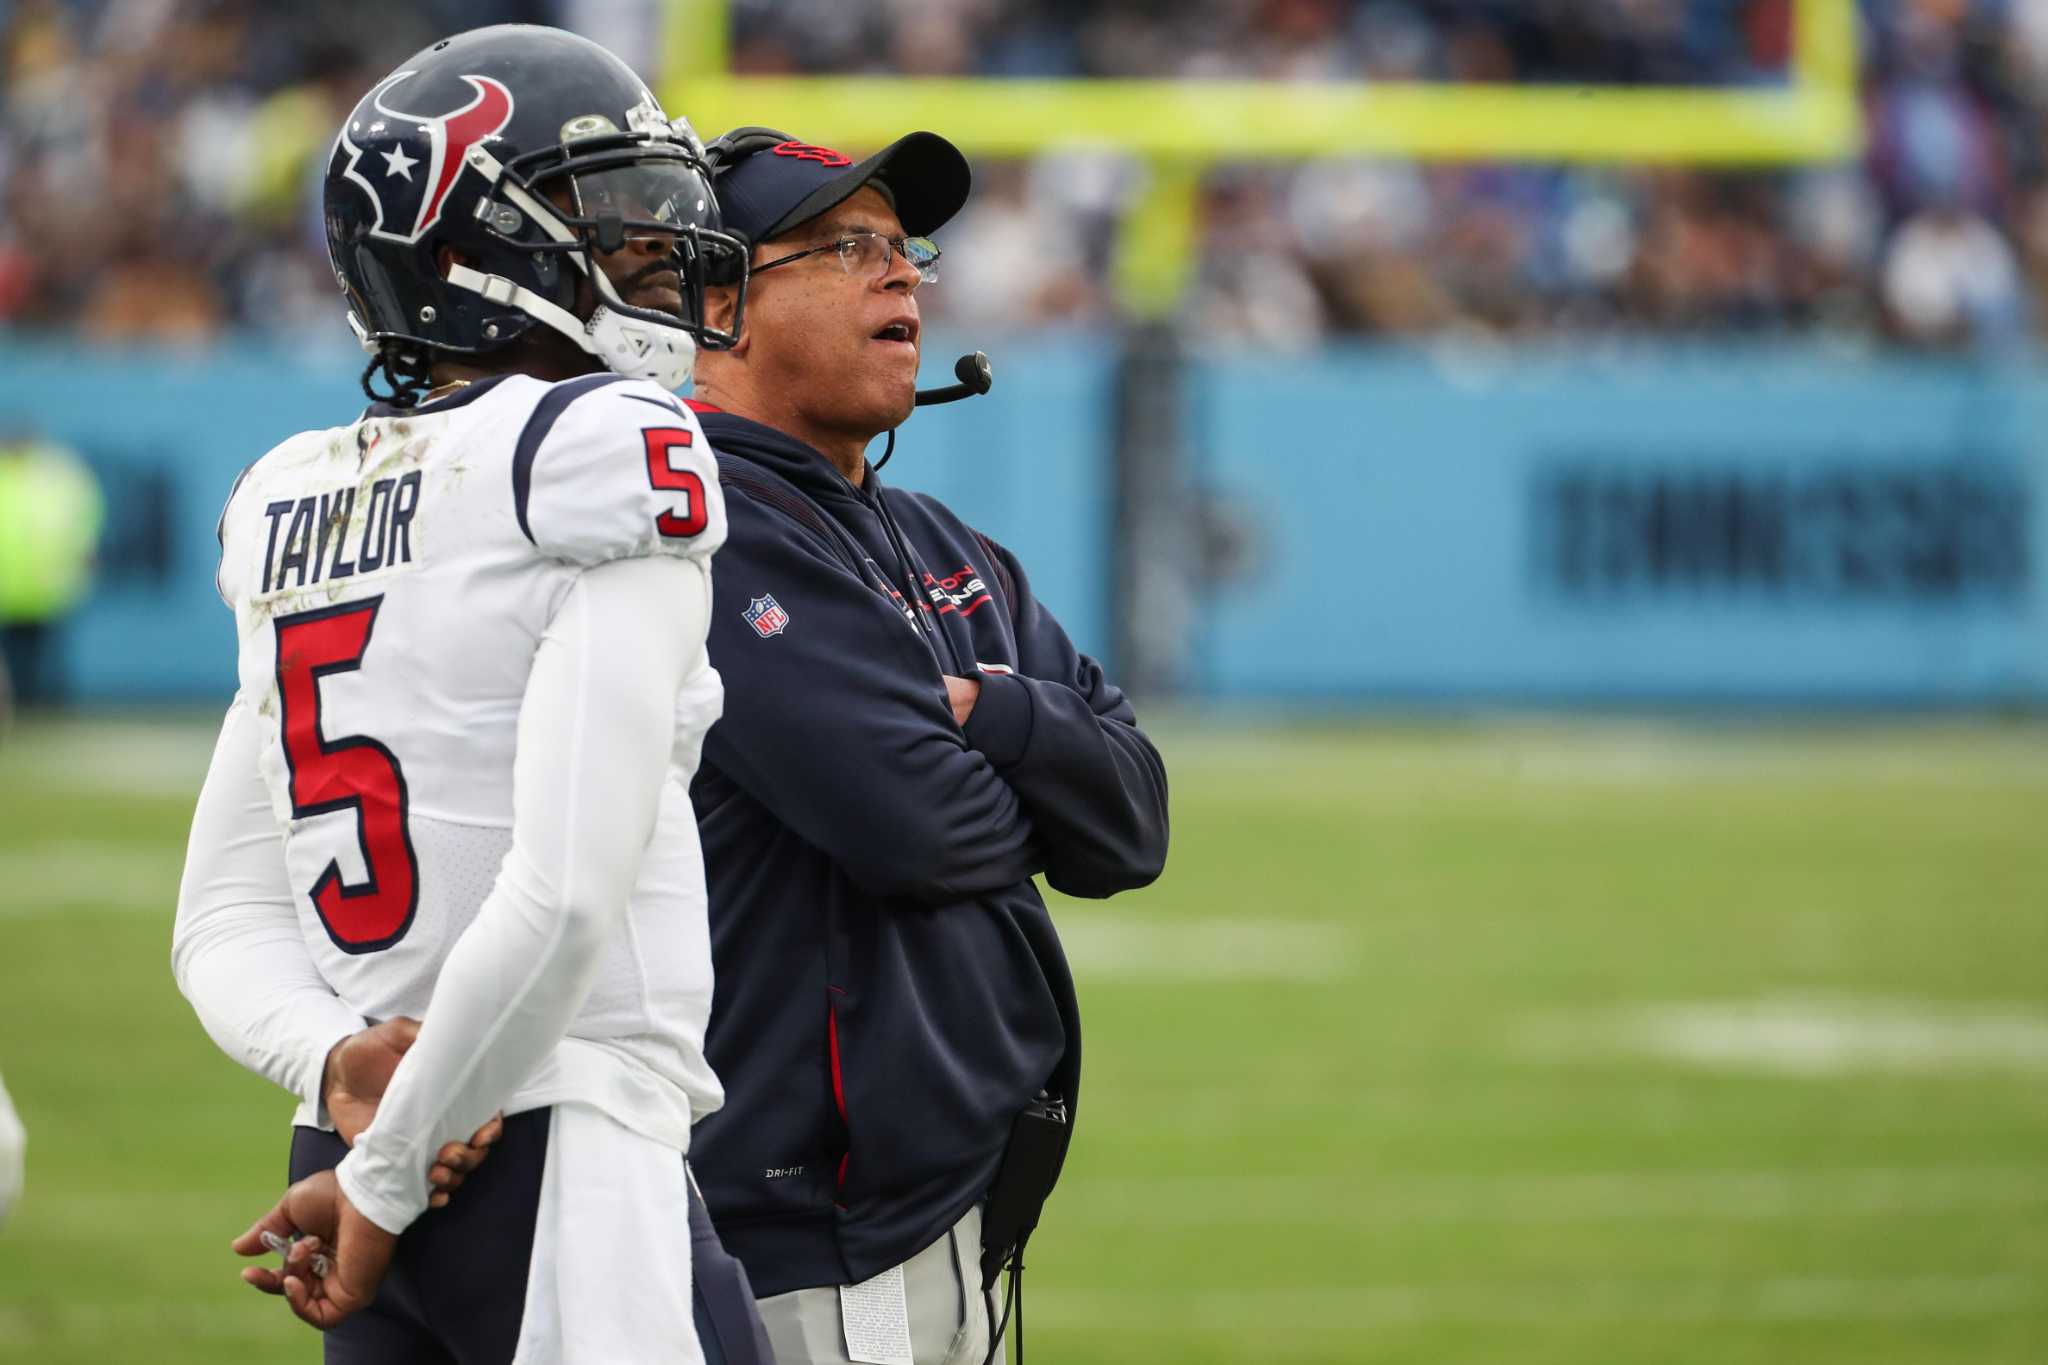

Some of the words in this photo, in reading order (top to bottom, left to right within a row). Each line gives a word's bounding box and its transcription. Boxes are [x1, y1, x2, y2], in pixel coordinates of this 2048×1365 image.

[261, 469, 422, 594] TAYLOR
[640, 427, 709, 538] 5
[755, 606, 786, 635] NFL
[273, 592, 419, 955] 5
[765, 1166, 804, 1178] DRI-FIT
